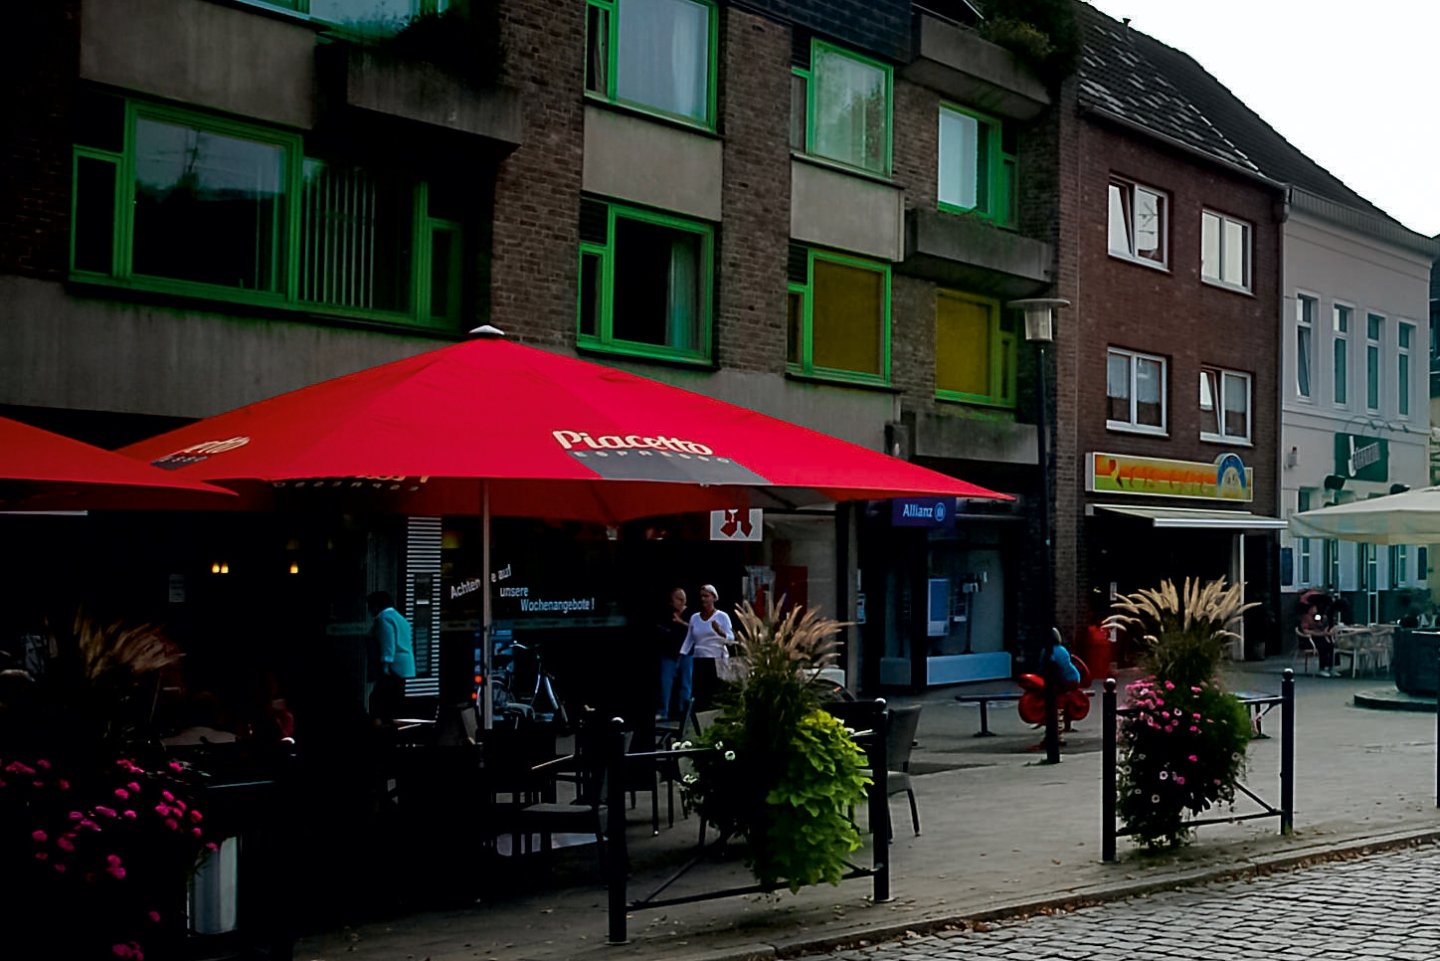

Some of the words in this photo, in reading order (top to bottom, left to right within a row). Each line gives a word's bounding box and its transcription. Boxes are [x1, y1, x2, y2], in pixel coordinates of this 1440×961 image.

[552, 429, 714, 456] Piacetto
[902, 503, 933, 518] Allianz
[450, 578, 481, 599] Achten
[500, 587, 528, 597] unsere
